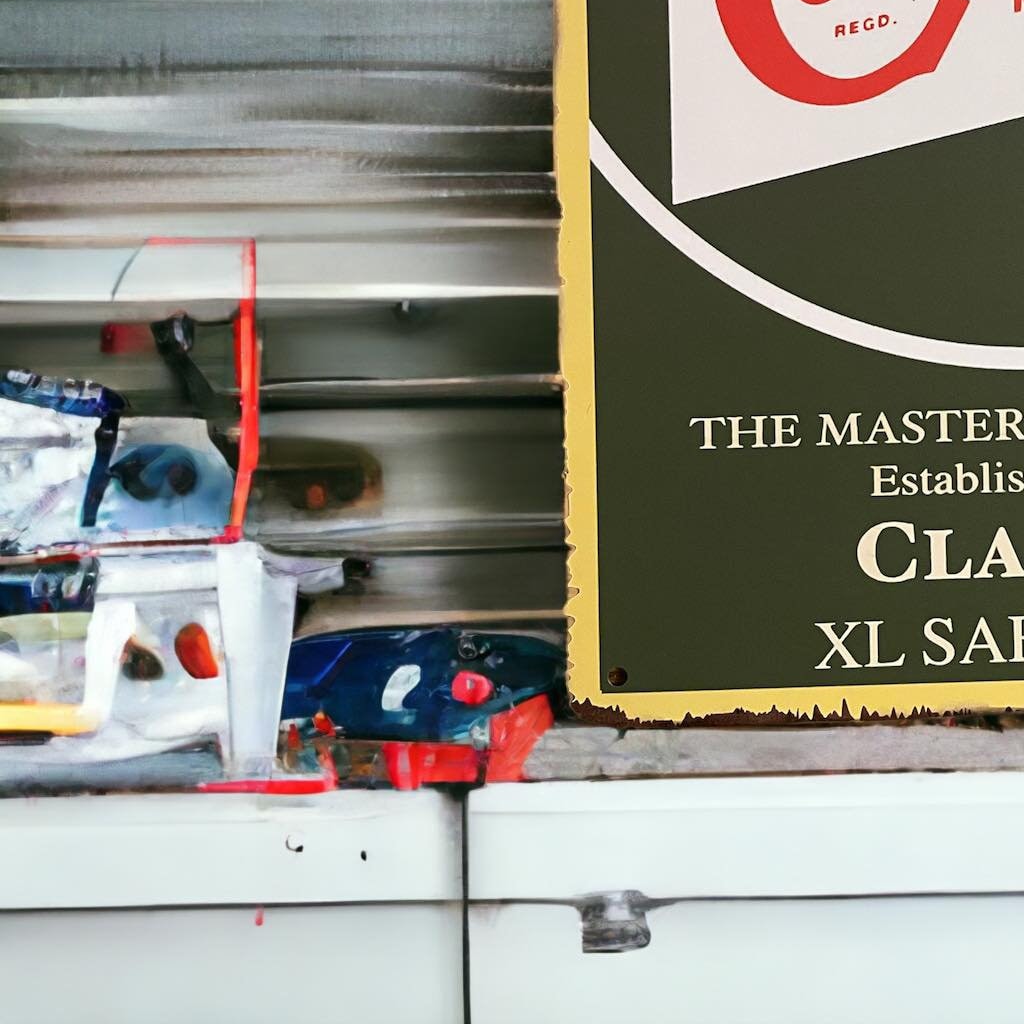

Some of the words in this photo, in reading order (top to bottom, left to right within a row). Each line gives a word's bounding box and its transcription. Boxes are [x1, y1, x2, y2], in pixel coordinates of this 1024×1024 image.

[834, 14, 897, 37] REGD.
[688, 414, 802, 450] THE
[814, 620, 906, 670] XL
